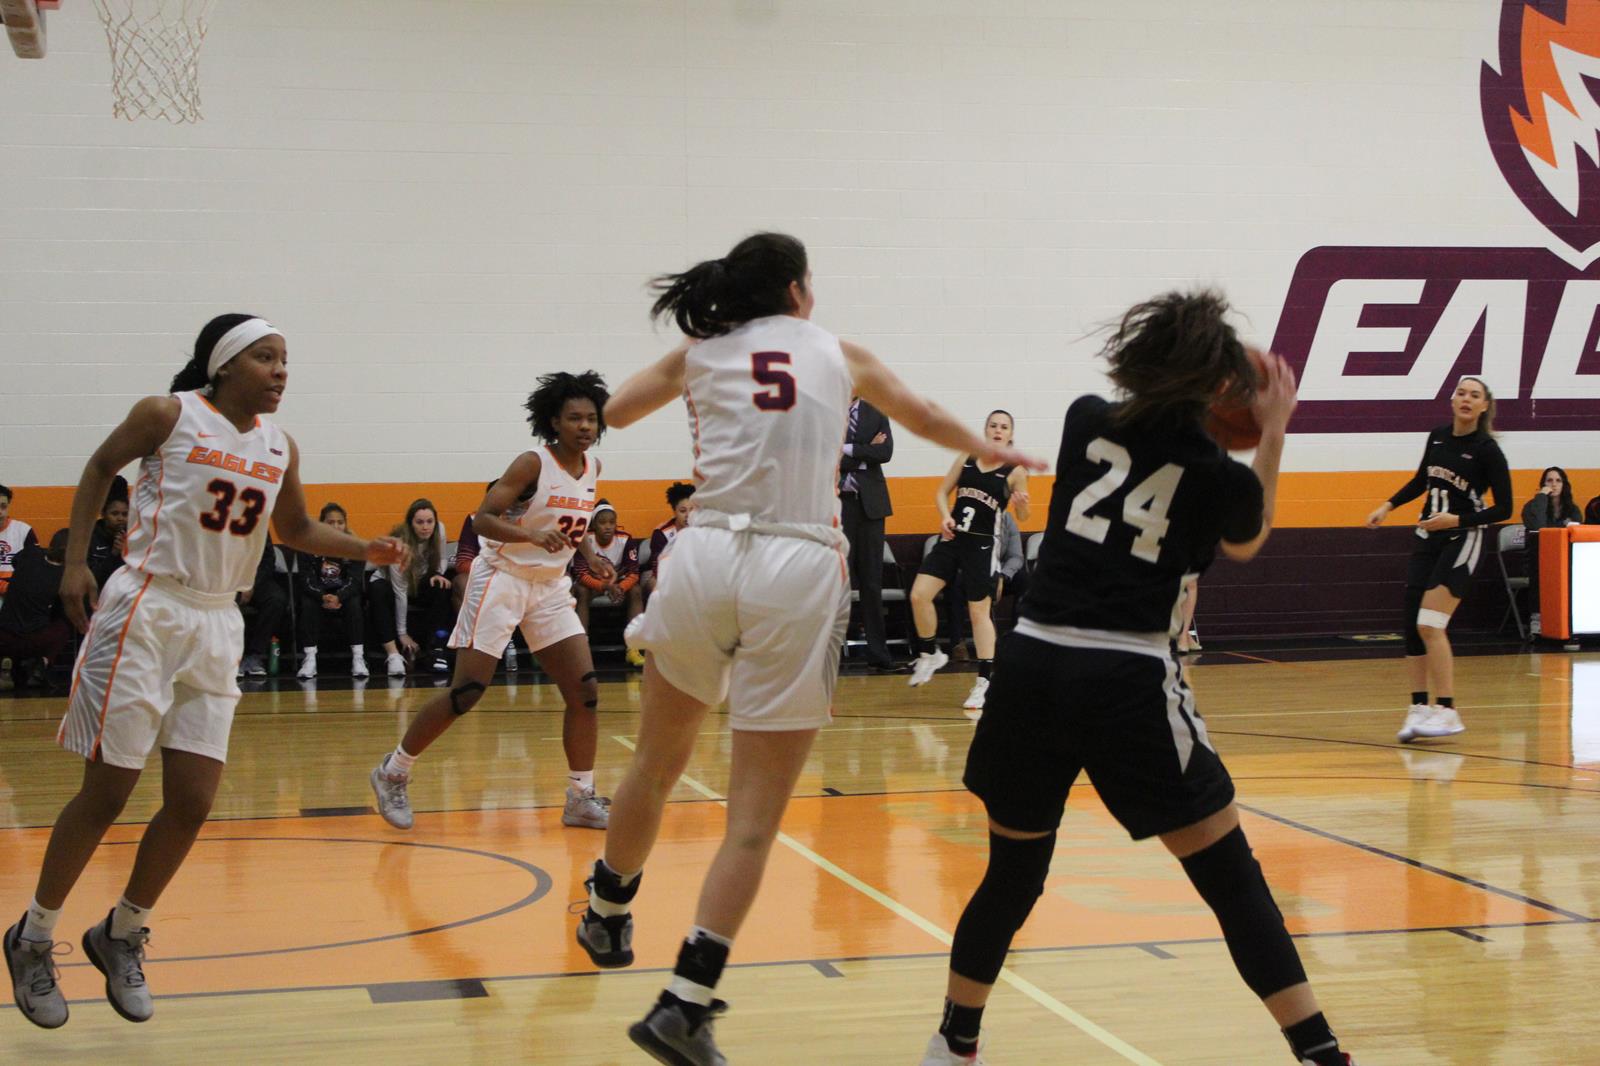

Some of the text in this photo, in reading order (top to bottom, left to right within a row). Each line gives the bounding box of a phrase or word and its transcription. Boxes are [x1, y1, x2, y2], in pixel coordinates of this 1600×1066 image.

[750, 350, 797, 412] 5
[186, 446, 284, 484] EAGLES
[199, 477, 266, 537] 33
[956, 506, 976, 532] 3
[1065, 437, 1185, 565] 24
[1428, 487, 1450, 517] 11
